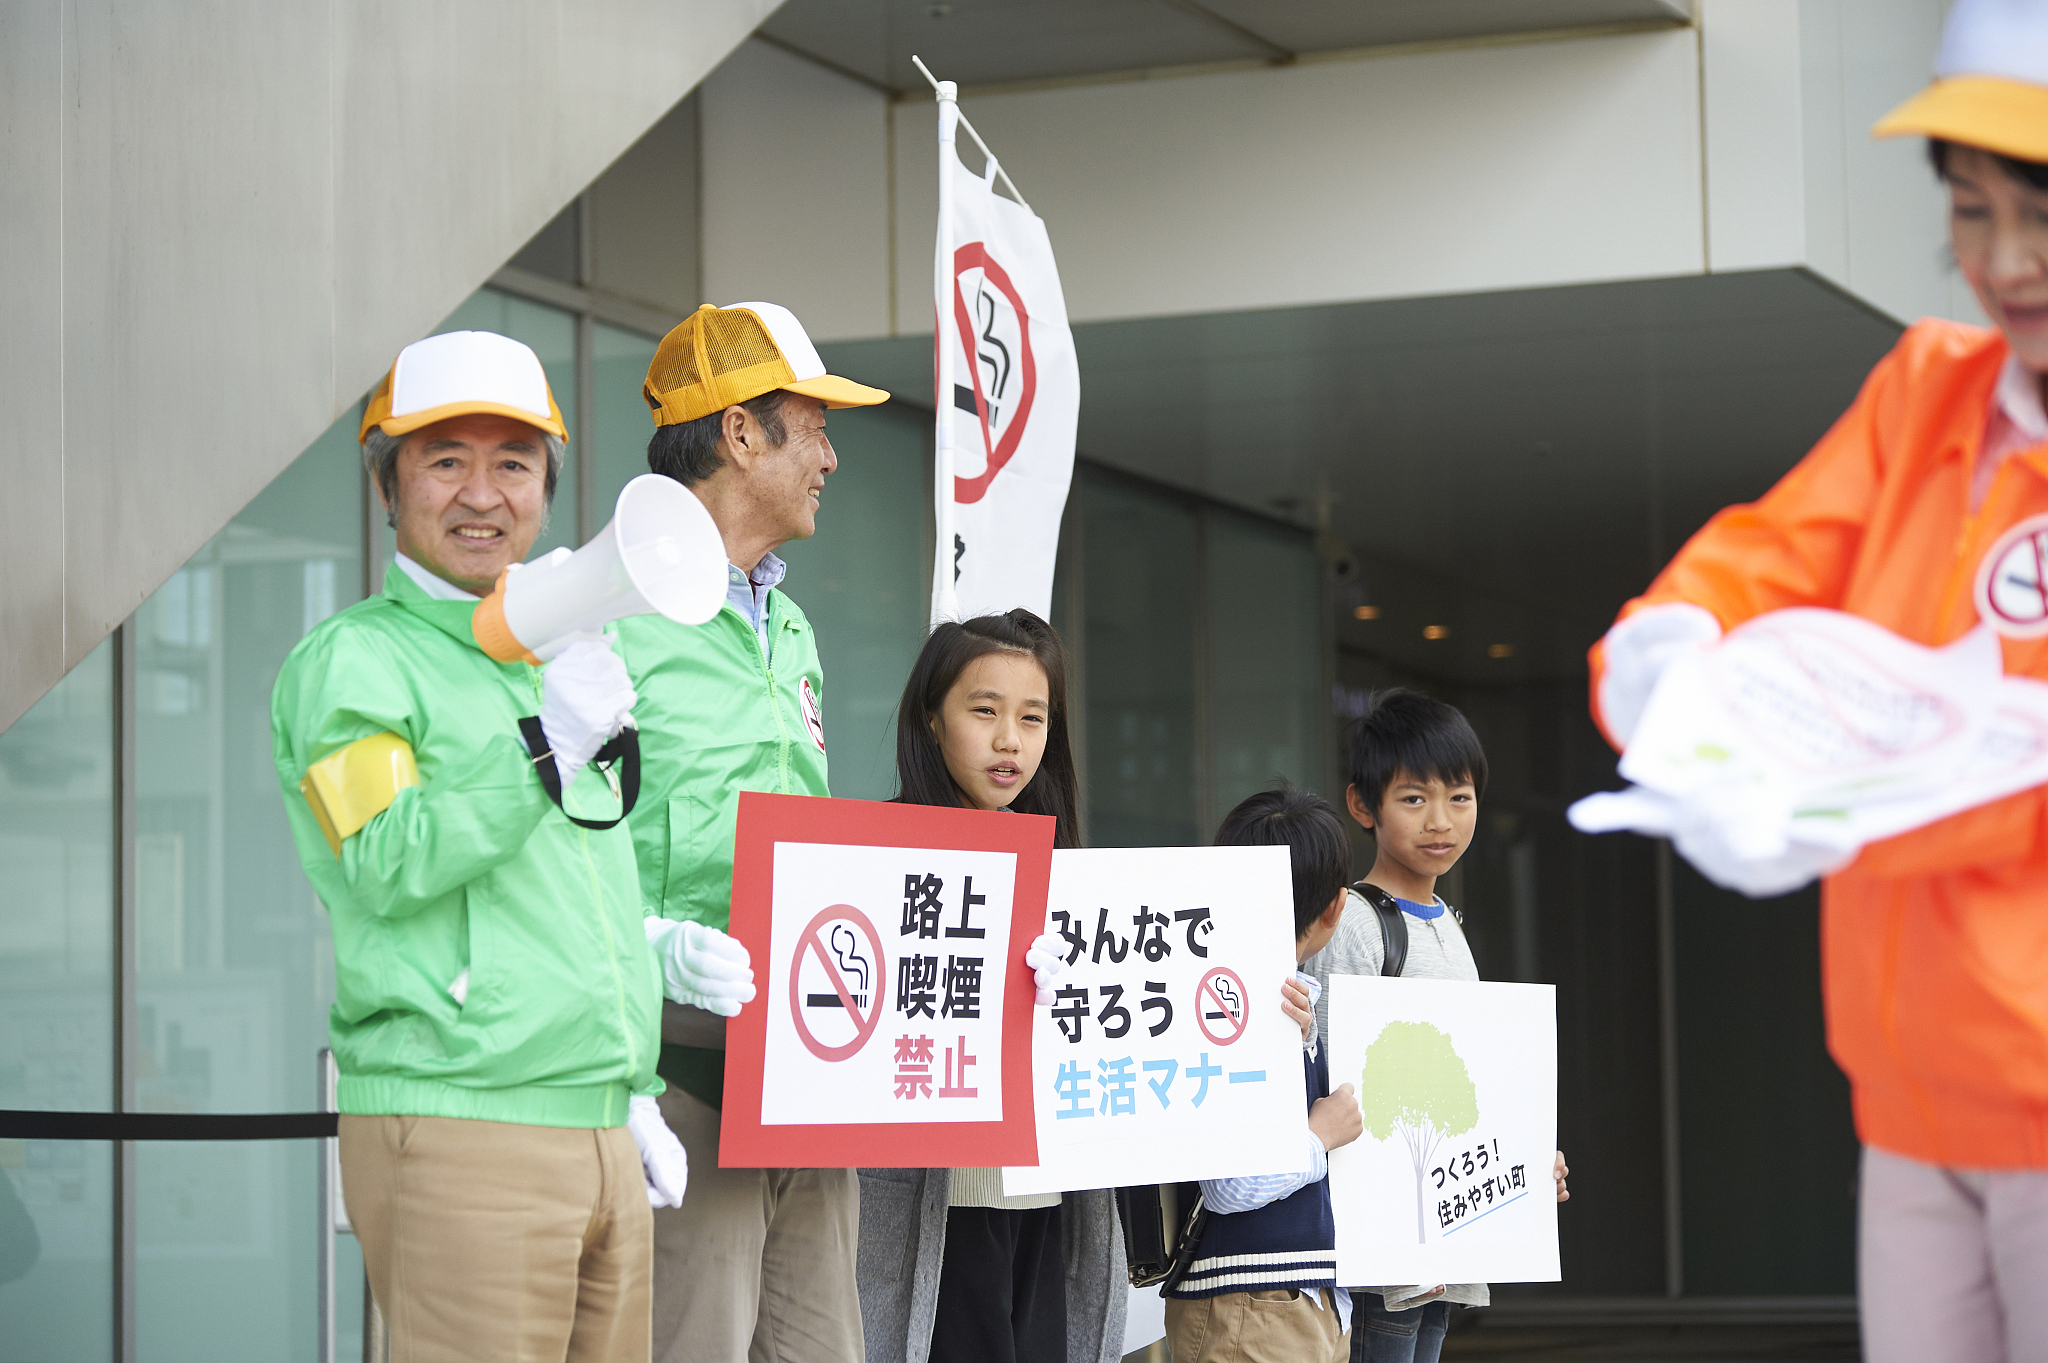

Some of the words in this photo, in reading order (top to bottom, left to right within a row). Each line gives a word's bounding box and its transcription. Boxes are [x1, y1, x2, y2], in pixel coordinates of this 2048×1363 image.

[900, 872, 986, 940] 路上
[1051, 905, 1215, 967] みんなで
[896, 953, 985, 1020] 喫煙
[1051, 980, 1174, 1044] 守ろう
[893, 1033, 978, 1100] 禁止
[1053, 1052, 1267, 1120] 生活マナー
[1430, 1138, 1500, 1190] つくろう！
[1437, 1164, 1527, 1229] 住みやすい町
